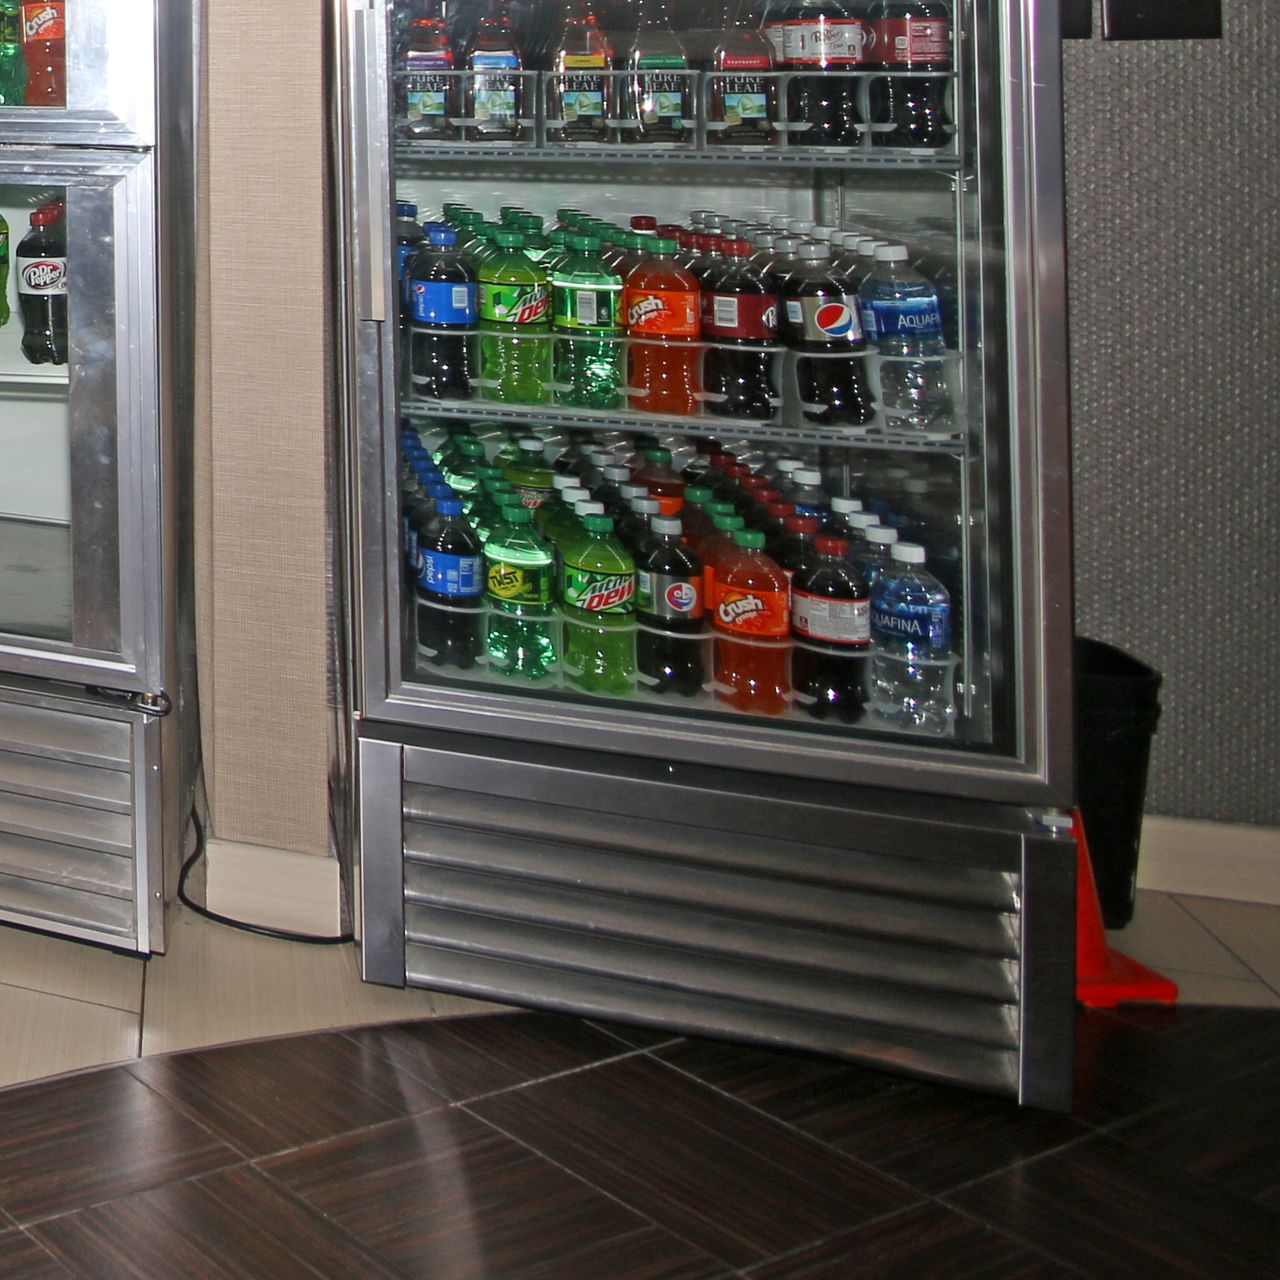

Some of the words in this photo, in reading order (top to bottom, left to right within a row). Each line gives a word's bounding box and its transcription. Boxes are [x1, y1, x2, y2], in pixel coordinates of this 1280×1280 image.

[26, 6, 58, 36] Crush
[29, 267, 61, 286] Pepper
[426, 555, 435, 584] pepsi
[718, 596, 765, 623] Crush
